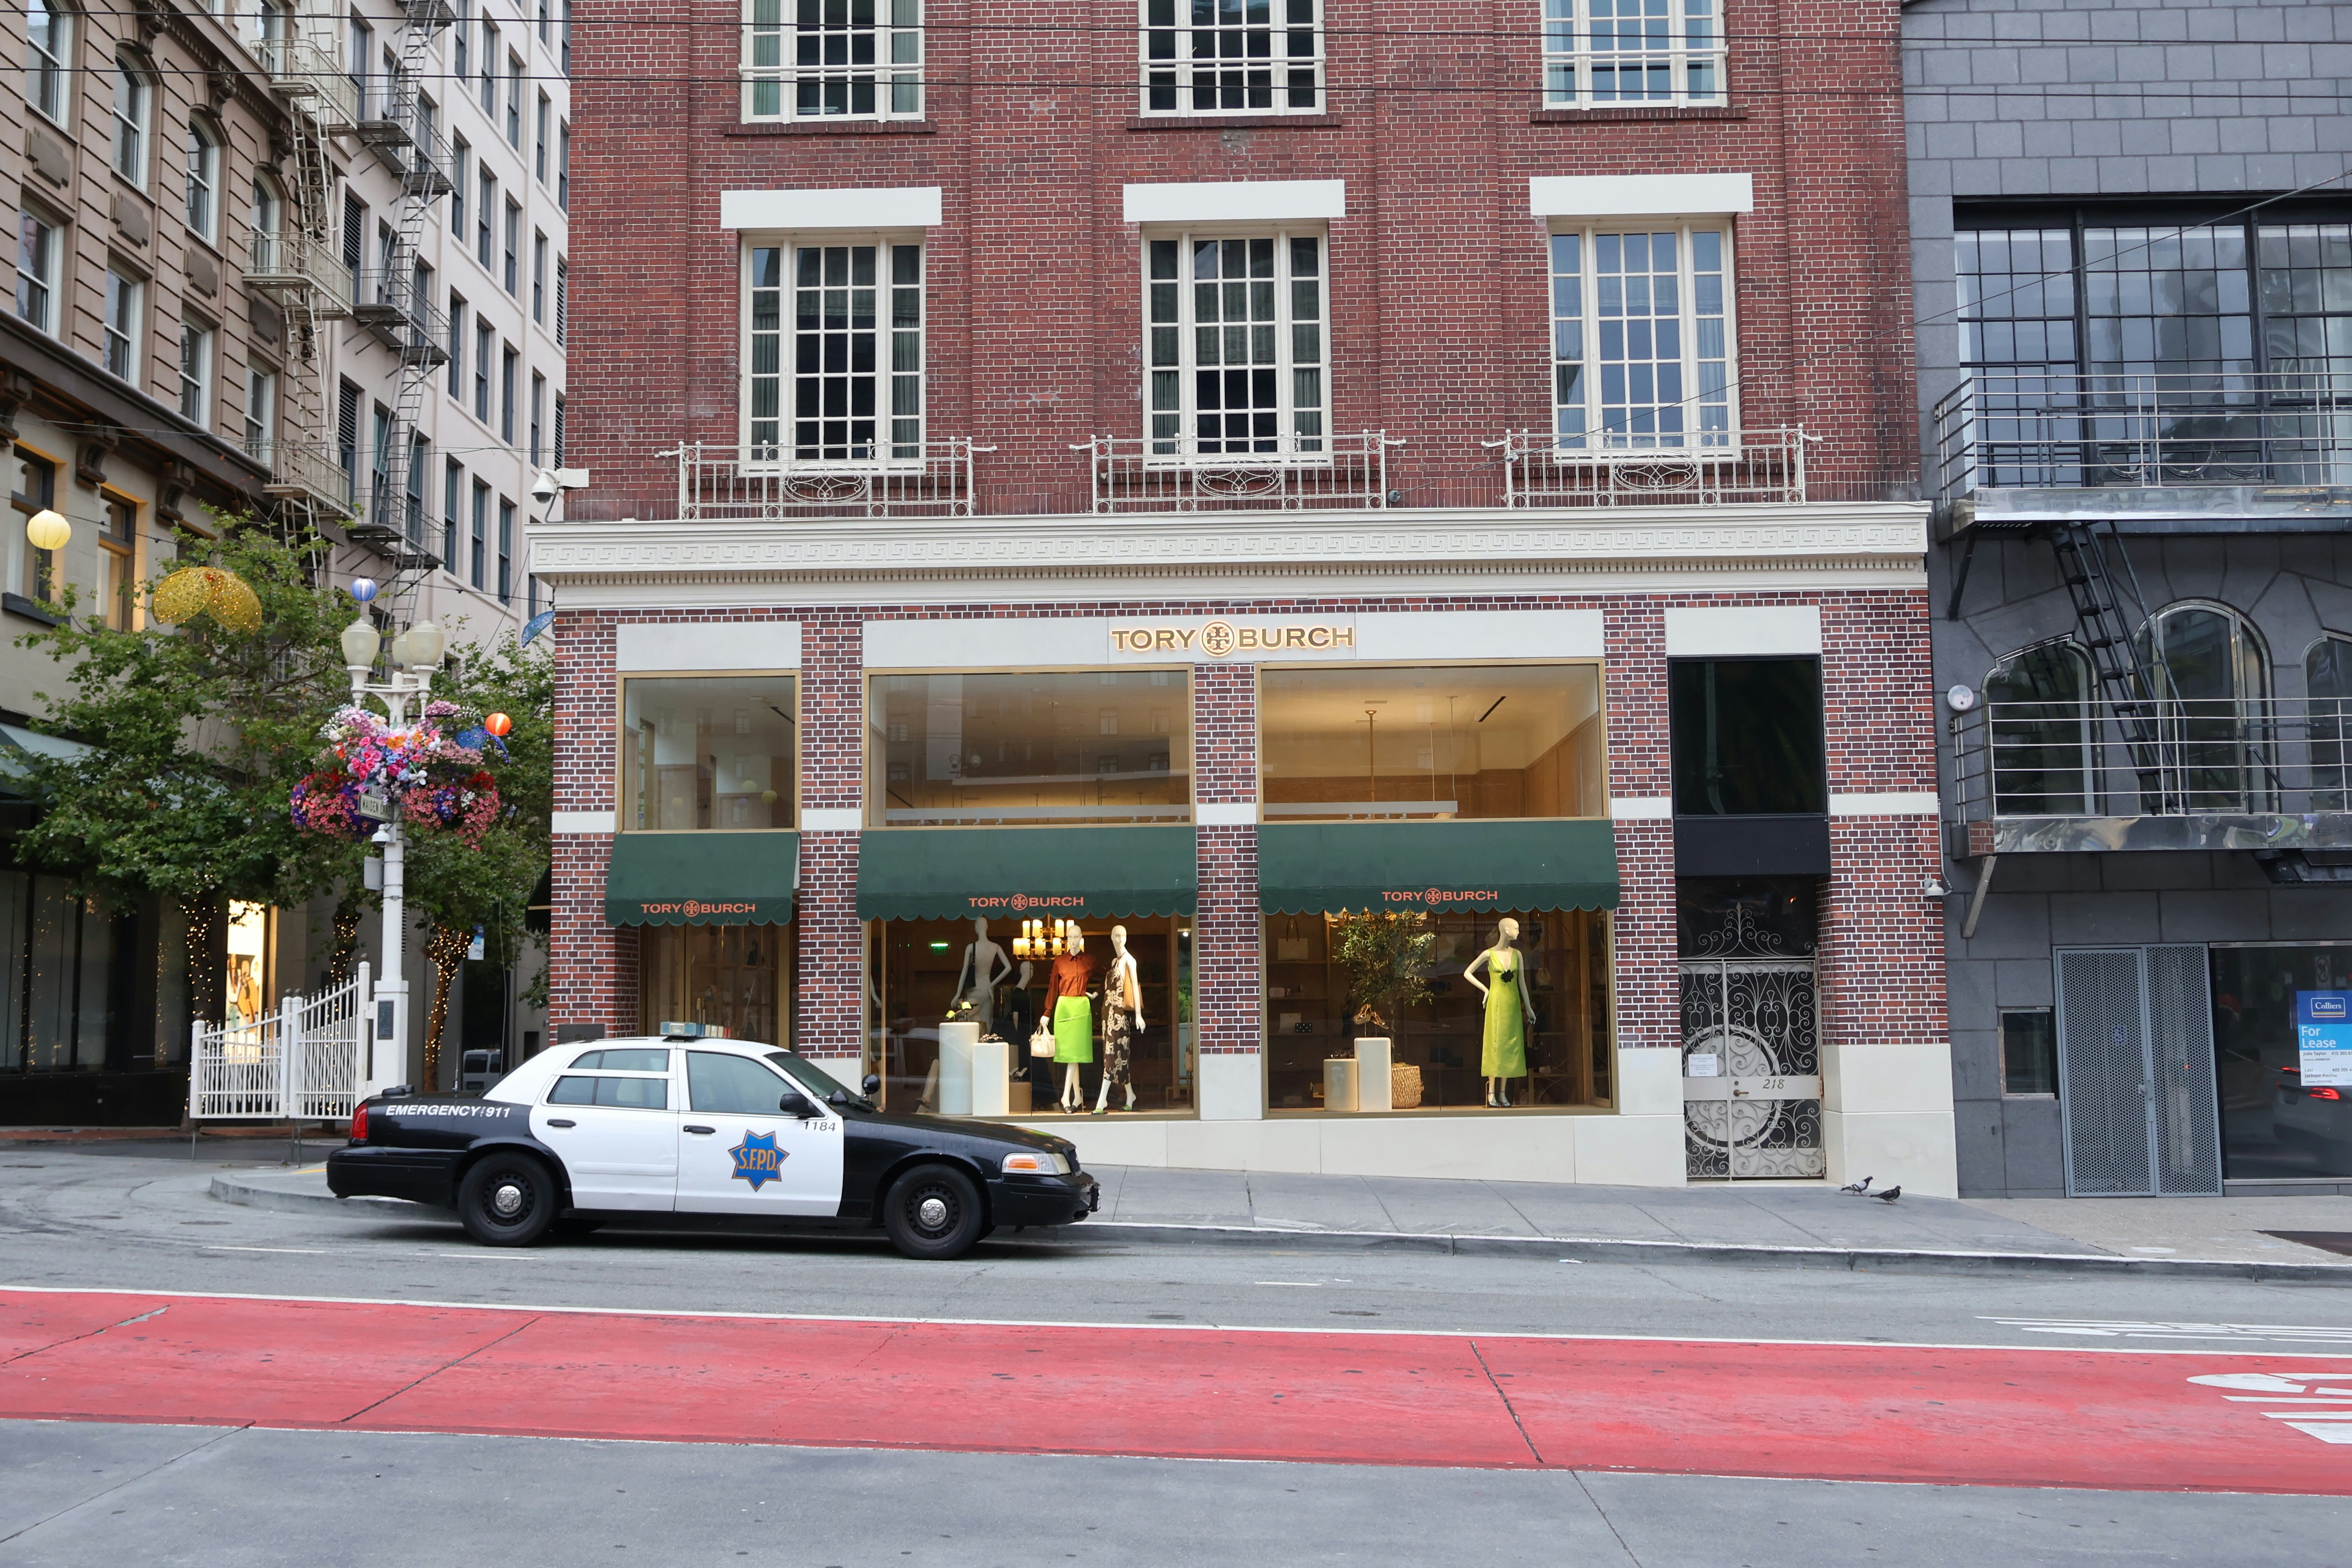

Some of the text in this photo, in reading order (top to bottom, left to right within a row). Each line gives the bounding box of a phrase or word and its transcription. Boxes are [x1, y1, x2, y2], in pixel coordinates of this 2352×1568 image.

[1111, 626, 1353, 650] TORY BURCH
[1382, 891, 1498, 901] TORY BURCH
[968, 897, 1084, 907] TORY BURCH
[641, 903, 756, 913] TORY BURCH
[2301, 1026, 2321, 1036] For
[2302, 1038, 2336, 1048] Lease
[1762, 1078, 1785, 1090] 218
[385, 1104, 481, 1117] EMERGENCY
[485, 1106, 511, 1118] 911
[803, 1121, 836, 1132] 1184
[738, 1148, 777, 1171] S.F.P.D.
